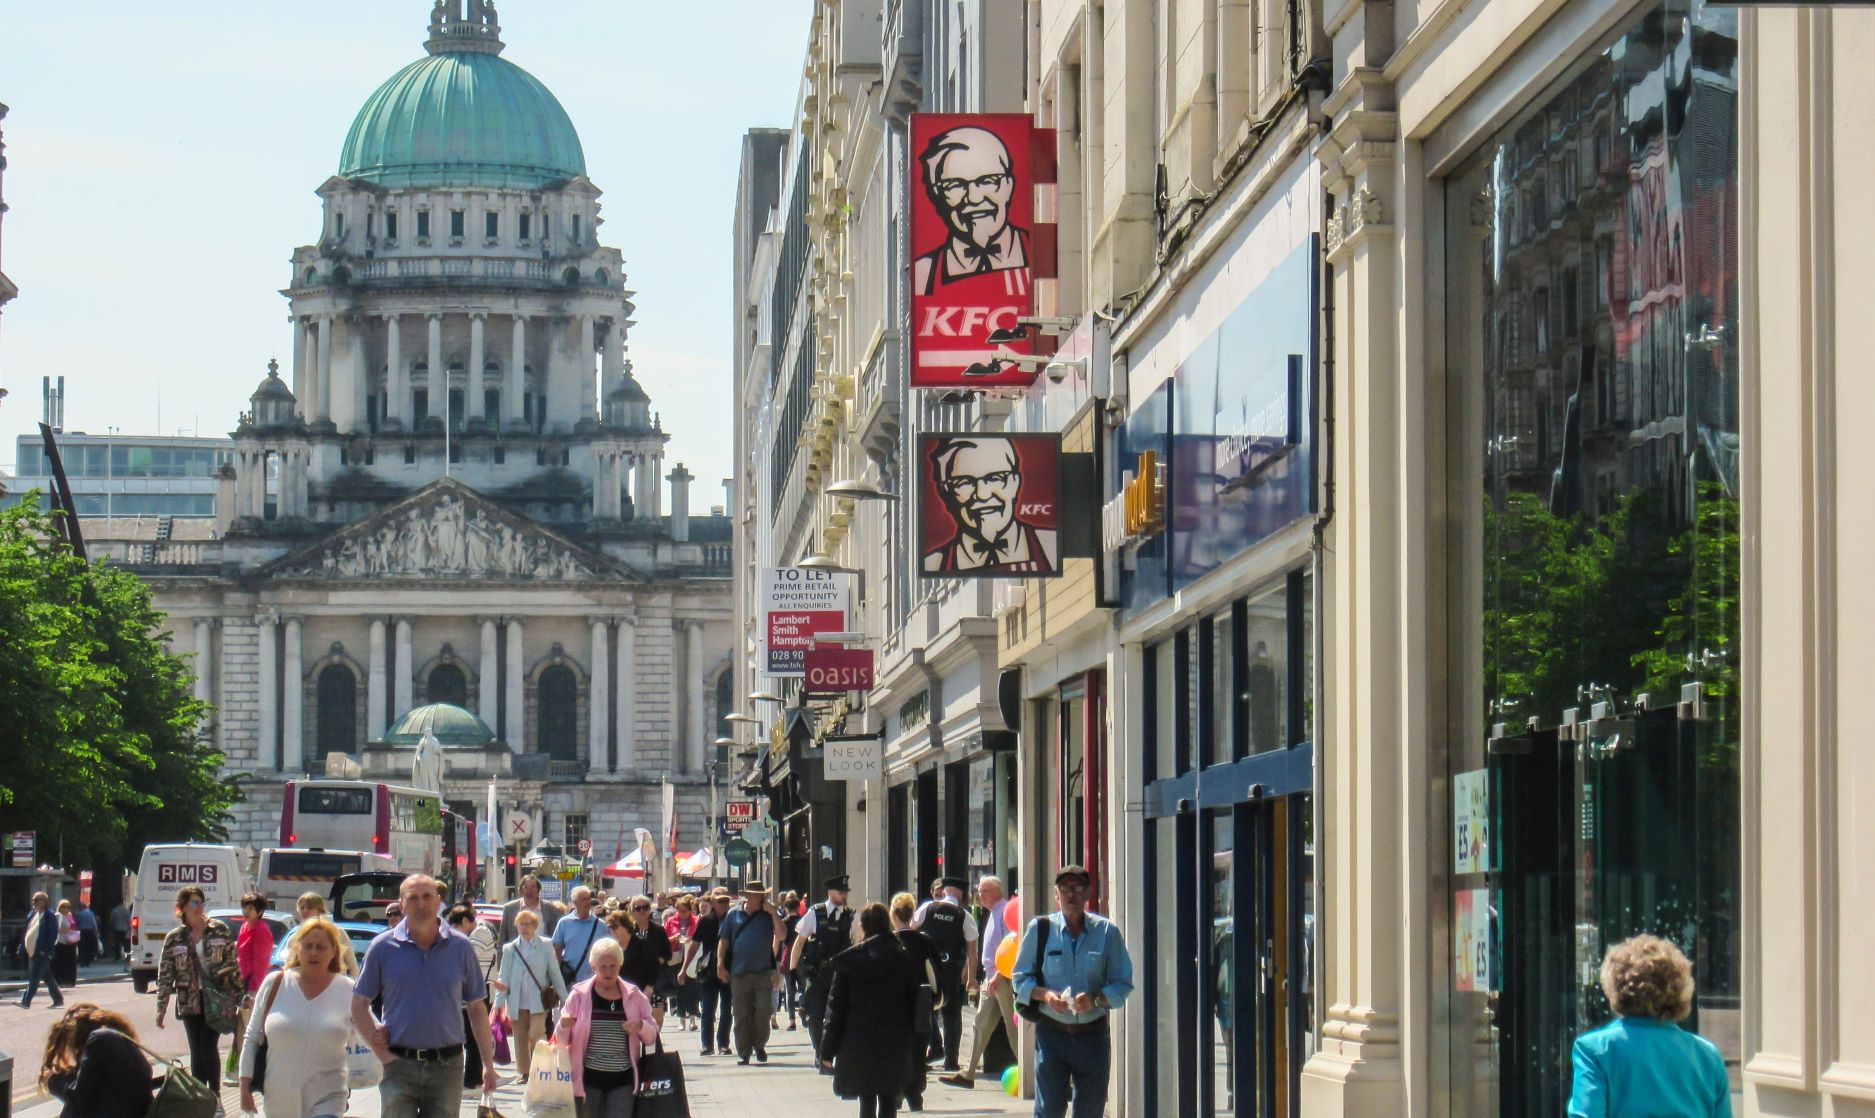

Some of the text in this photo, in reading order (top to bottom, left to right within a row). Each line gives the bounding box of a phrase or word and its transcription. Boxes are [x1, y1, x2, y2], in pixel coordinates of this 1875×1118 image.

[918, 306, 1019, 337] KFC
[1020, 504, 1052, 515] KFC
[776, 568, 833, 581] TO LET
[774, 583, 837, 591] PRIME RETAIL
[772, 592, 838, 601] OPPORTUNITY
[793, 602, 832, 610] ENQUIRIES
[772, 615, 811, 625] Lambert
[772, 625, 798, 635] Smith
[772, 650, 804, 660] 028 90
[811, 667, 868, 685] oasis
[833, 747, 872, 758] NEW
[829, 761, 877, 771] LOOK
[729, 804, 750, 816] DW
[1458, 823, 1468, 861] £5
[161, 866, 214, 881] RMS
[933, 913, 954, 921] POLICE
[1476, 941, 1486, 978] £5
